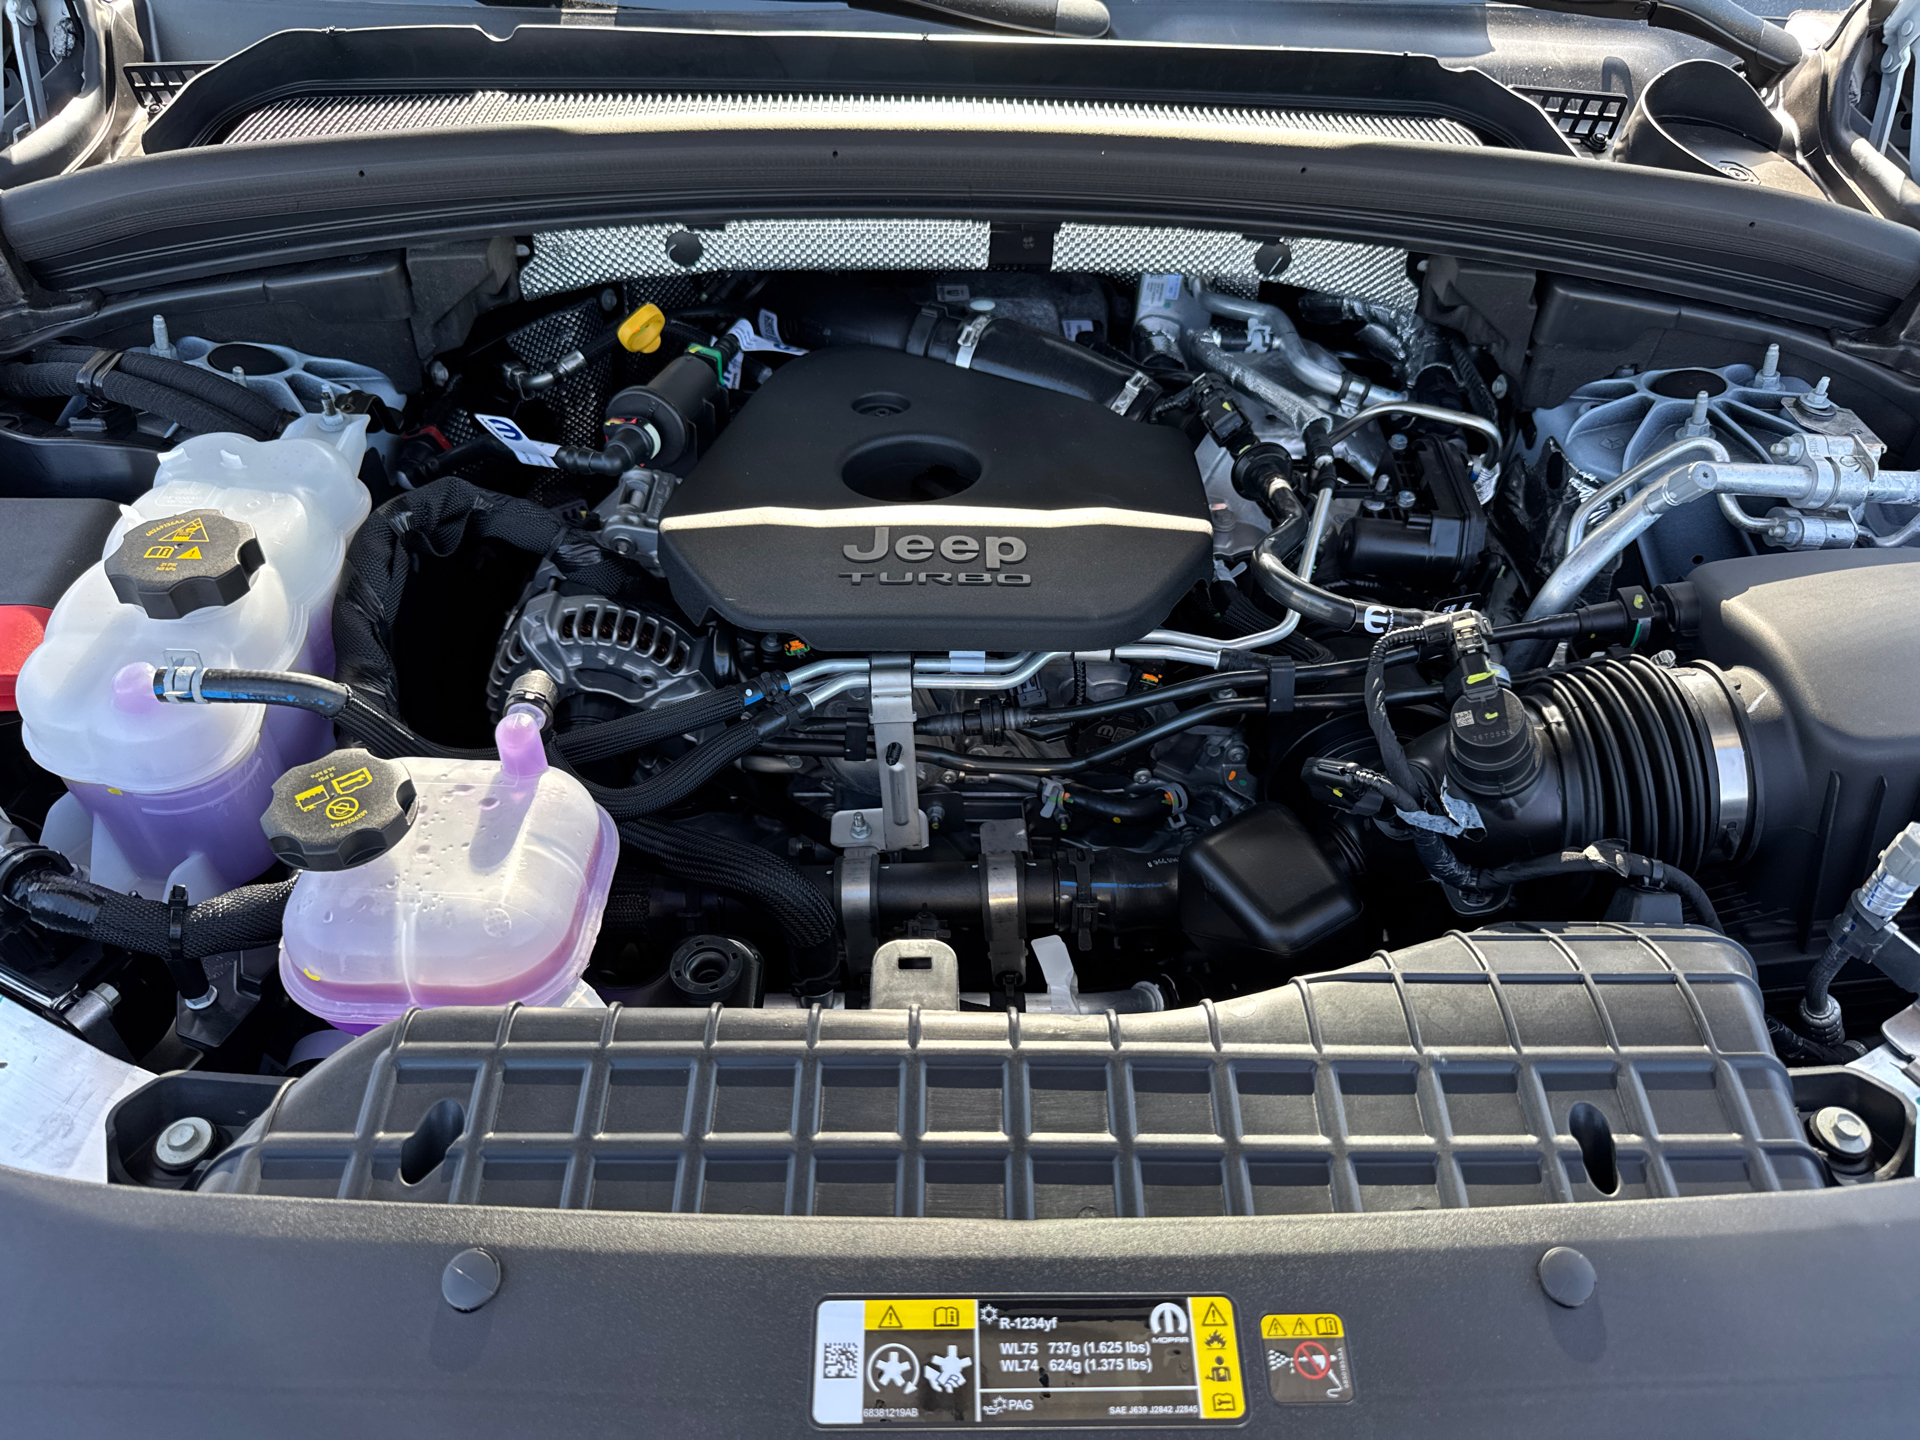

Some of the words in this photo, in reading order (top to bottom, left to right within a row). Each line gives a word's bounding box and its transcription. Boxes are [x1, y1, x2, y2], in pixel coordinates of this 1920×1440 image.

[842, 527, 1028, 571] Jeep
[838, 572, 1032, 586] TURBO
[999, 1317, 1058, 1332] R-1234yf
[1151, 1336, 1189, 1344] MOPAR
[1000, 1342, 1039, 1355] WL75
[1047, 1341, 1081, 1357] 737g
[1083, 1341, 1123, 1357] (1.625
[1125, 1341, 1151, 1356] lbs)
[1000, 1359, 1040, 1372] WL74
[1048, 1359, 1082, 1374] 624g
[1084, 1358, 1125, 1374] (1.375
[1126, 1358, 1153, 1373] lbs)
[1008, 1399, 1034, 1411] PAG
[1108, 1406, 1127, 1415] SAE
[1128, 1405, 1148, 1414] J639
[1149, 1405, 1173, 1414] J2842
[1174, 1404, 1198, 1413] J2845
[863, 1407, 919, 1418] 68381219AB
